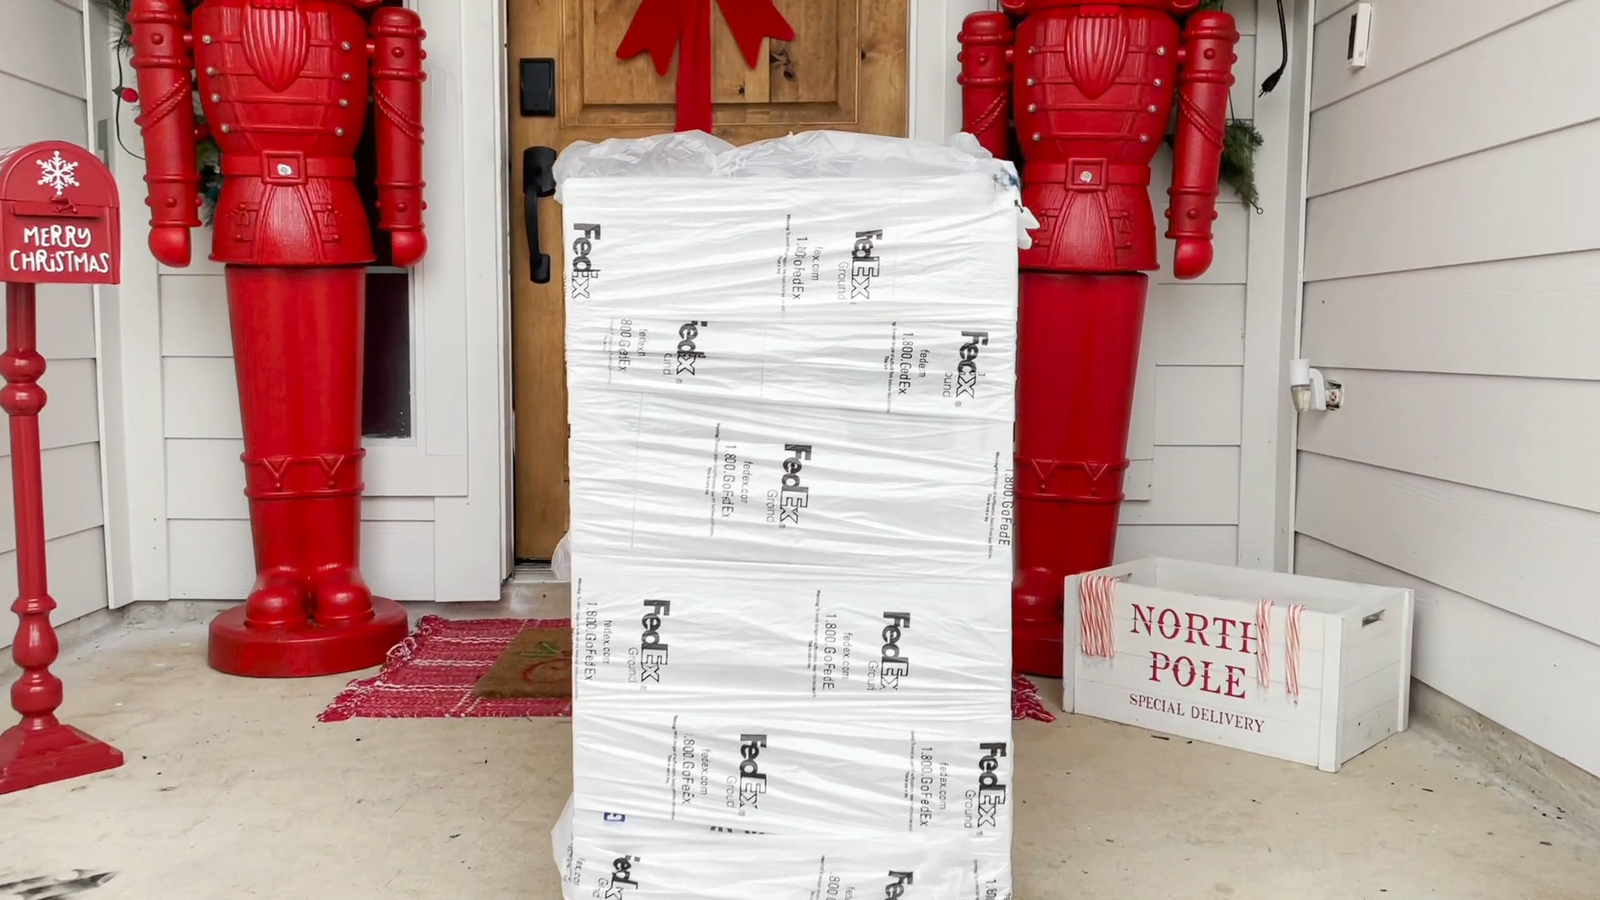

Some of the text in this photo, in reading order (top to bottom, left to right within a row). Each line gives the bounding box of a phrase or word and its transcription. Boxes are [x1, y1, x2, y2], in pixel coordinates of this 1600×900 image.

[24, 225, 92, 248] MERRY
[851, 229, 883, 300] FedEx
[838, 261, 850, 300] Ground
[780, 443, 812, 524] FedEx
[998, 468, 1013, 546] 1.800.GoFedE
[640, 599, 671, 683] FedEx
[823, 614, 837, 690] 1.800.GoFedE
[842, 632, 853, 680] fedex.com
[880, 611, 911, 690] FedEx
[1130, 603, 1260, 655] NORTH
[1149, 651, 1247, 699] POLE
[1129, 693, 1265, 733] SPECIAL DELIVERY
[700, 748, 711, 796] fedex.com
[739, 733, 767, 809] FedEx
[919, 747, 933, 826] 1.800.GoFedEx
[939, 762, 949, 810] fedex.com
[978, 742, 1007, 827] FedEx
[964, 789, 976, 829] Ground
